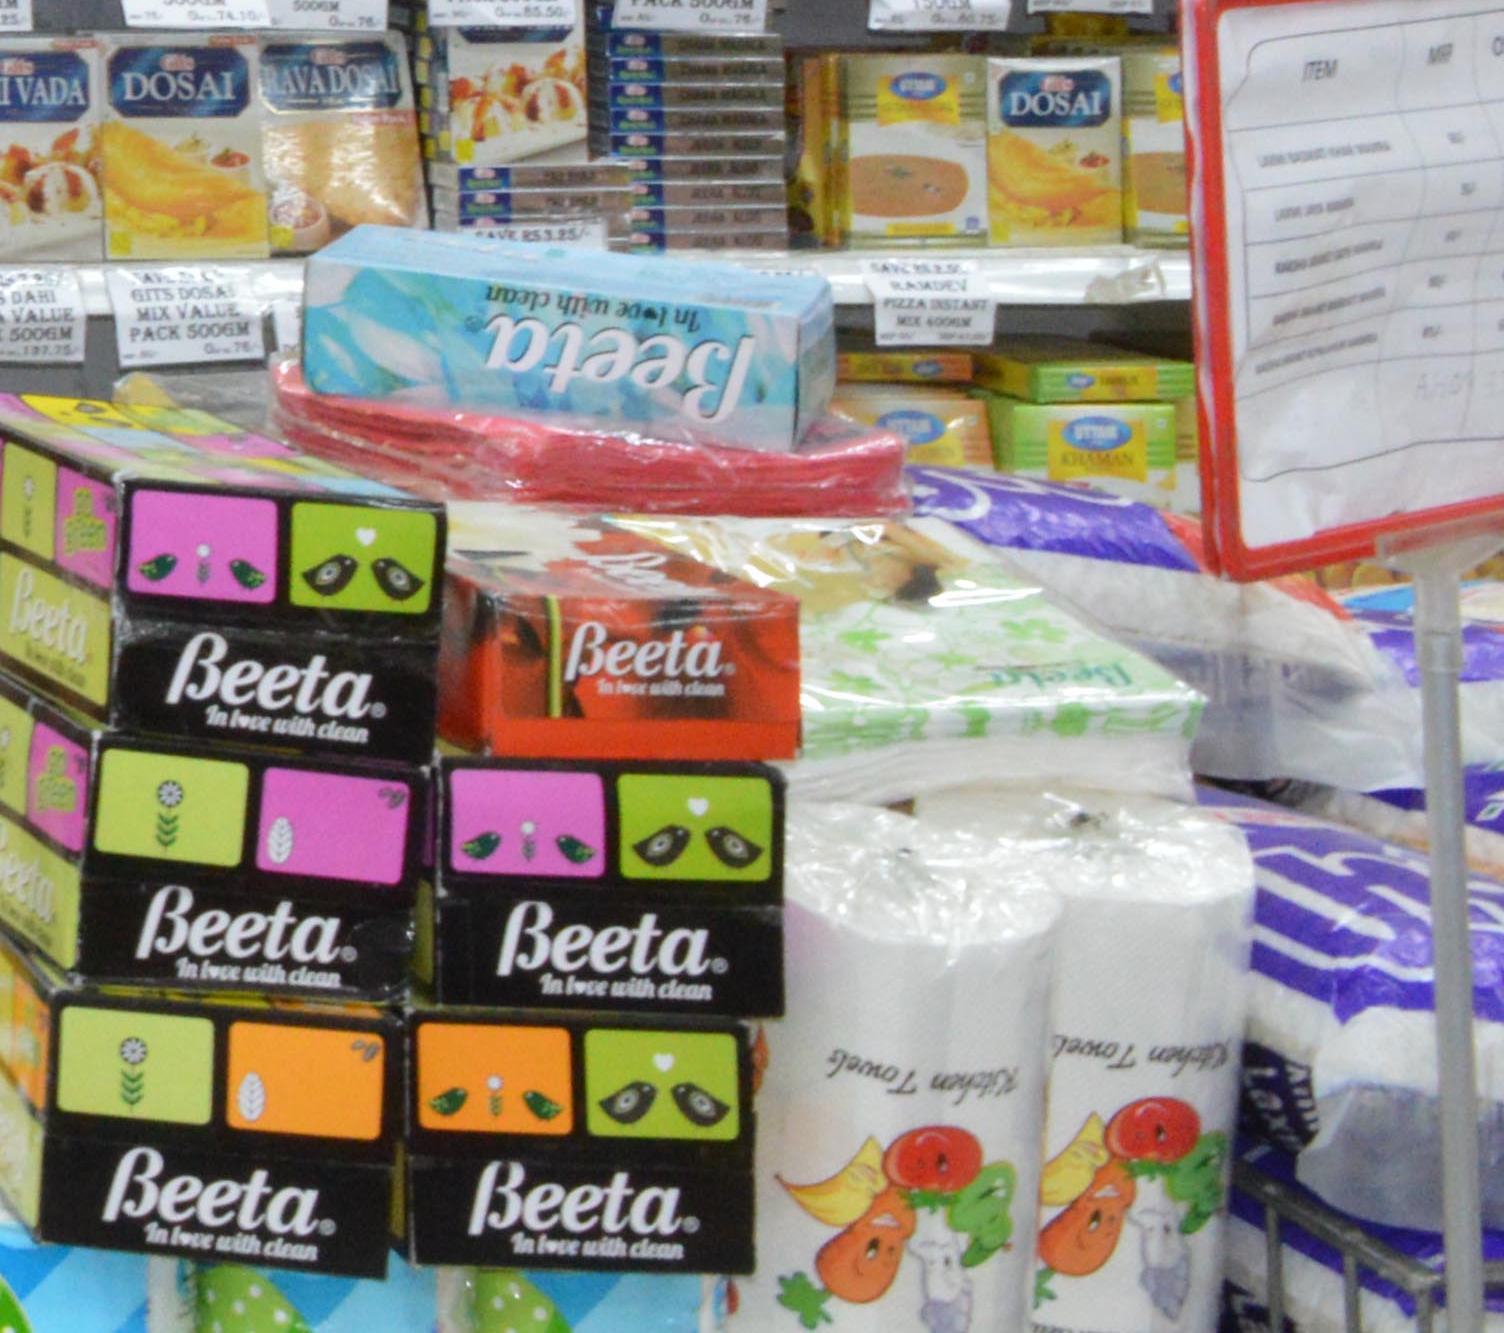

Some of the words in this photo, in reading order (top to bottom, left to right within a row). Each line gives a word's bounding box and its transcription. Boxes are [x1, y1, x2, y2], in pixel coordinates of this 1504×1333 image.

[122, 71, 236, 102] DOSAI
[1302, 59, 1338, 83] ITEM
[16, 77, 86, 107] VADA
[1009, 90, 1103, 117] DOSAI
[487, 286, 550, 311] clean
[558, 295, 608, 319] with
[483, 312, 755, 423] Beeta
[1060, 450, 1134, 467] KHAMAN
[564, 620, 723, 681] Beeta
[165, 631, 375, 719] Beeta
[275, 716, 315, 737] with
[317, 719, 369, 743] clean
[135, 884, 342, 967] Beeta
[496, 898, 712, 978] Beeta
[826, 1045, 921, 1097] Towels
[102, 1145, 321, 1237] Beeta
[468, 1159, 683, 1236] Beeta
